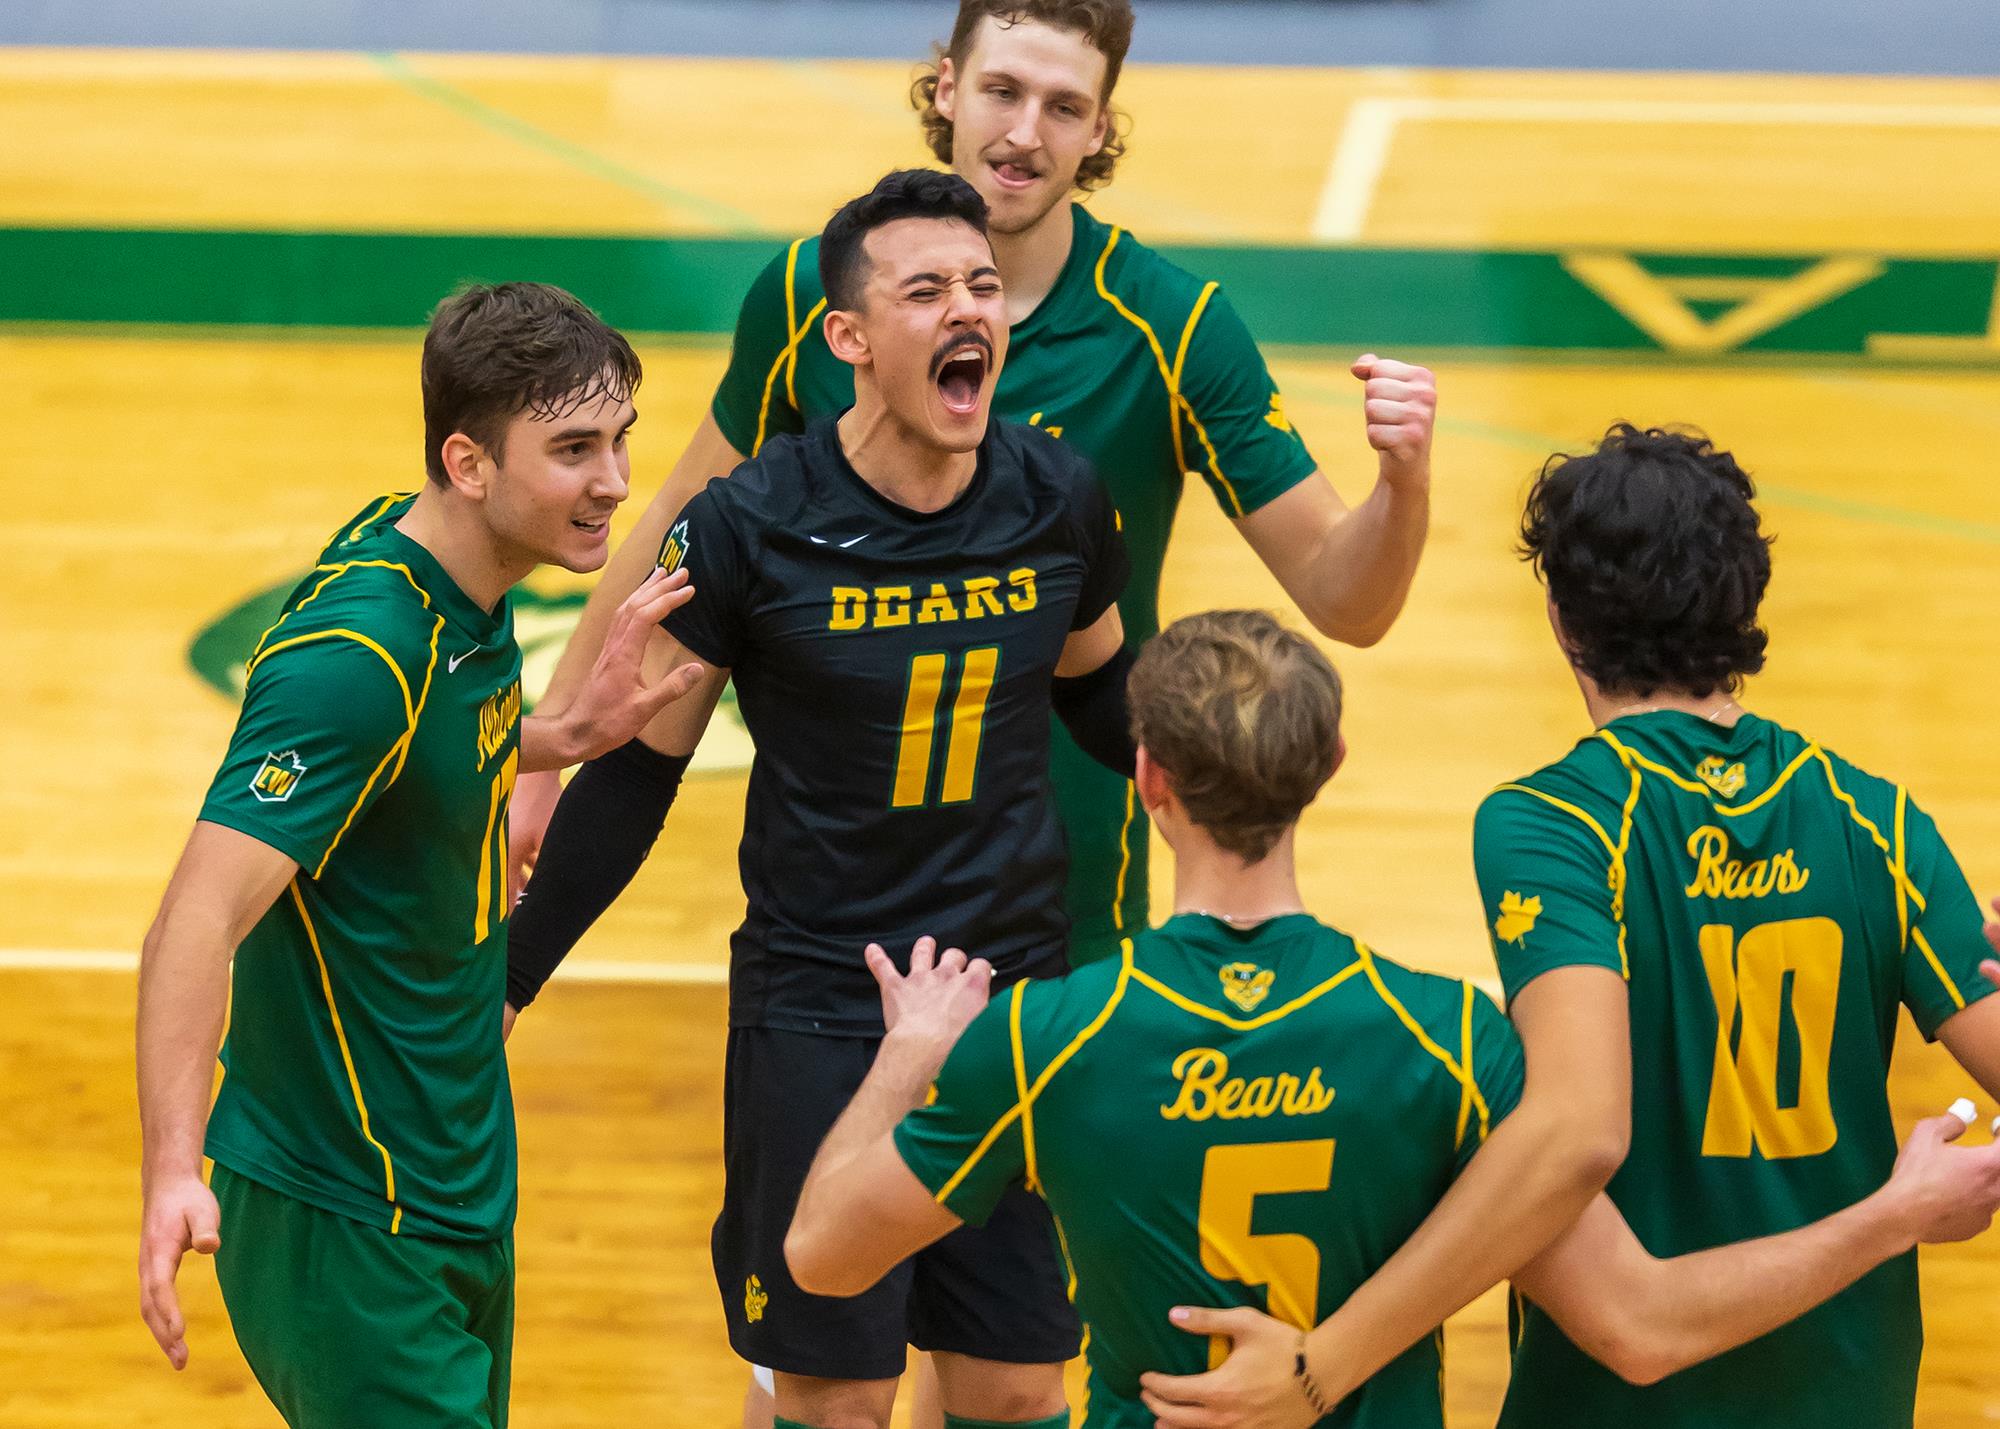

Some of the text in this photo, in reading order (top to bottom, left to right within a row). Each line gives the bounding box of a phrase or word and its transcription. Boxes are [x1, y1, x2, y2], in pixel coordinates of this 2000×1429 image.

[891, 646, 999, 809] 11
[474, 745, 519, 945] 17
[1685, 824, 1810, 899] Bears
[1159, 1047, 1336, 1121] Bears
[1697, 916, 1844, 1161] 10
[1197, 1137, 1337, 1372] 5
